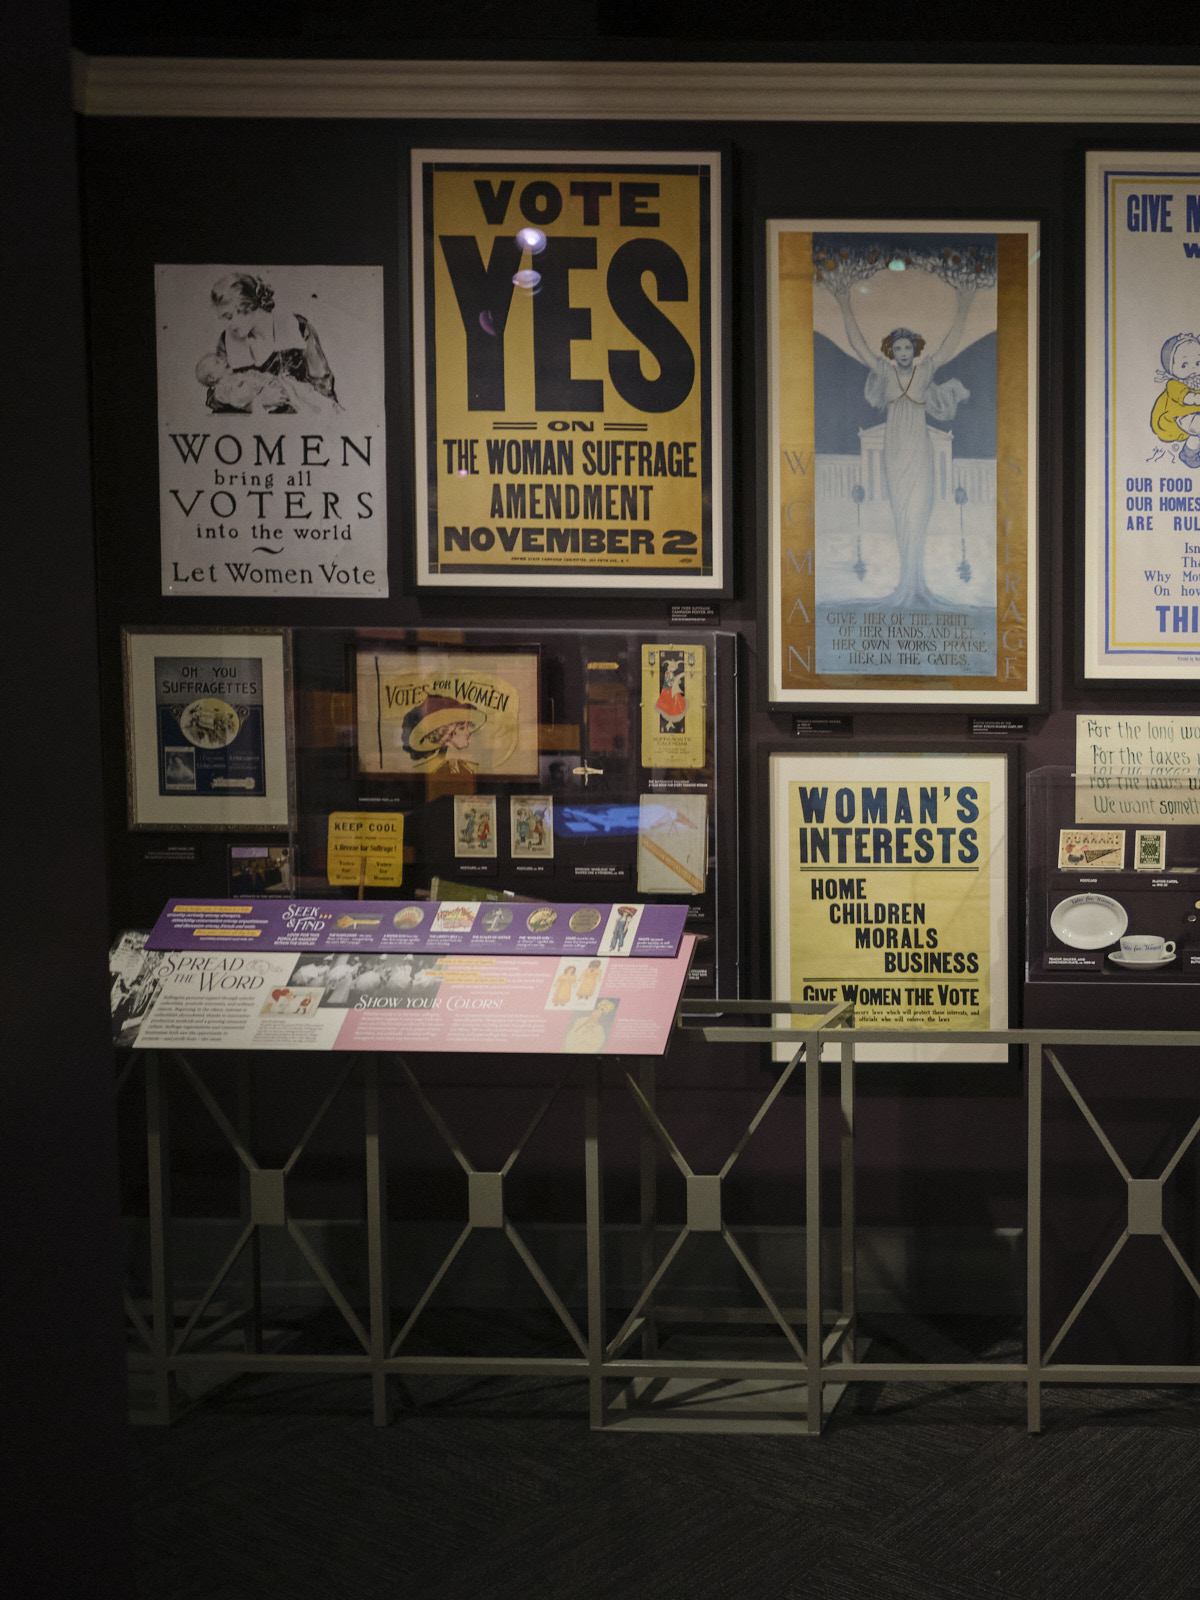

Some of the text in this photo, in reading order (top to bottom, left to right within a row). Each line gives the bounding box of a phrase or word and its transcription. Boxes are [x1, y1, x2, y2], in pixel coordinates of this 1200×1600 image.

[474, 180, 660, 227] VOTE
[1127, 194, 1173, 232] GIVE
[438, 235, 695, 414] YES
[547, 420, 594, 432] ON
[169, 434, 373, 467] WOMEN
[443, 439, 697, 478] THE WOMAN SUFFRAGE
[214, 469, 312, 489] bring all
[1126, 478, 1153, 493] OUR
[1160, 478, 1193, 493] FOOD
[170, 490, 373, 519] VOTERS
[490, 483, 653, 521] AMENDMENT
[197, 524, 352, 540] into the world
[1127, 516, 1154, 531] ARE
[444, 526, 698, 555] NOVEMBER 2
[172, 563, 375, 584] Let Women Vote
[1154, 585, 1171, 597] On
[832, 639, 855, 651] HER
[862, 639, 890, 651] OWN
[897, 640, 937, 652] WORKS
[849, 653, 879, 665] HER
[880, 653, 891, 664] IN
[897, 653, 921, 665] THE
[182, 666, 237, 678] OH YOU
[162, 681, 257, 695] SUFFRAGETTES
[385, 679, 509, 711] VOTES FOR WOMEN
[1087, 719, 1111, 738] For
[1118, 721, 1141, 739] the
[1148, 721, 1174, 743] long
[798, 786, 979, 824] WOMAN'S
[334, 822, 397, 832] KEEP COOL
[799, 828, 979, 864] INTERESTS
[811, 878, 867, 900] HOME
[829, 903, 926, 924] CHILDREN
[855, 928, 938, 949] MORALS
[162, 952, 245, 977] SPREAD
[884, 952, 979, 973] BUSINESS
[199, 972, 265, 992] WORD
[354, 994, 403, 1012] SHOW
[406, 997, 442, 1009] YOUR
[803, 985, 980, 1006] GIVE WOMEN THE VOTE
